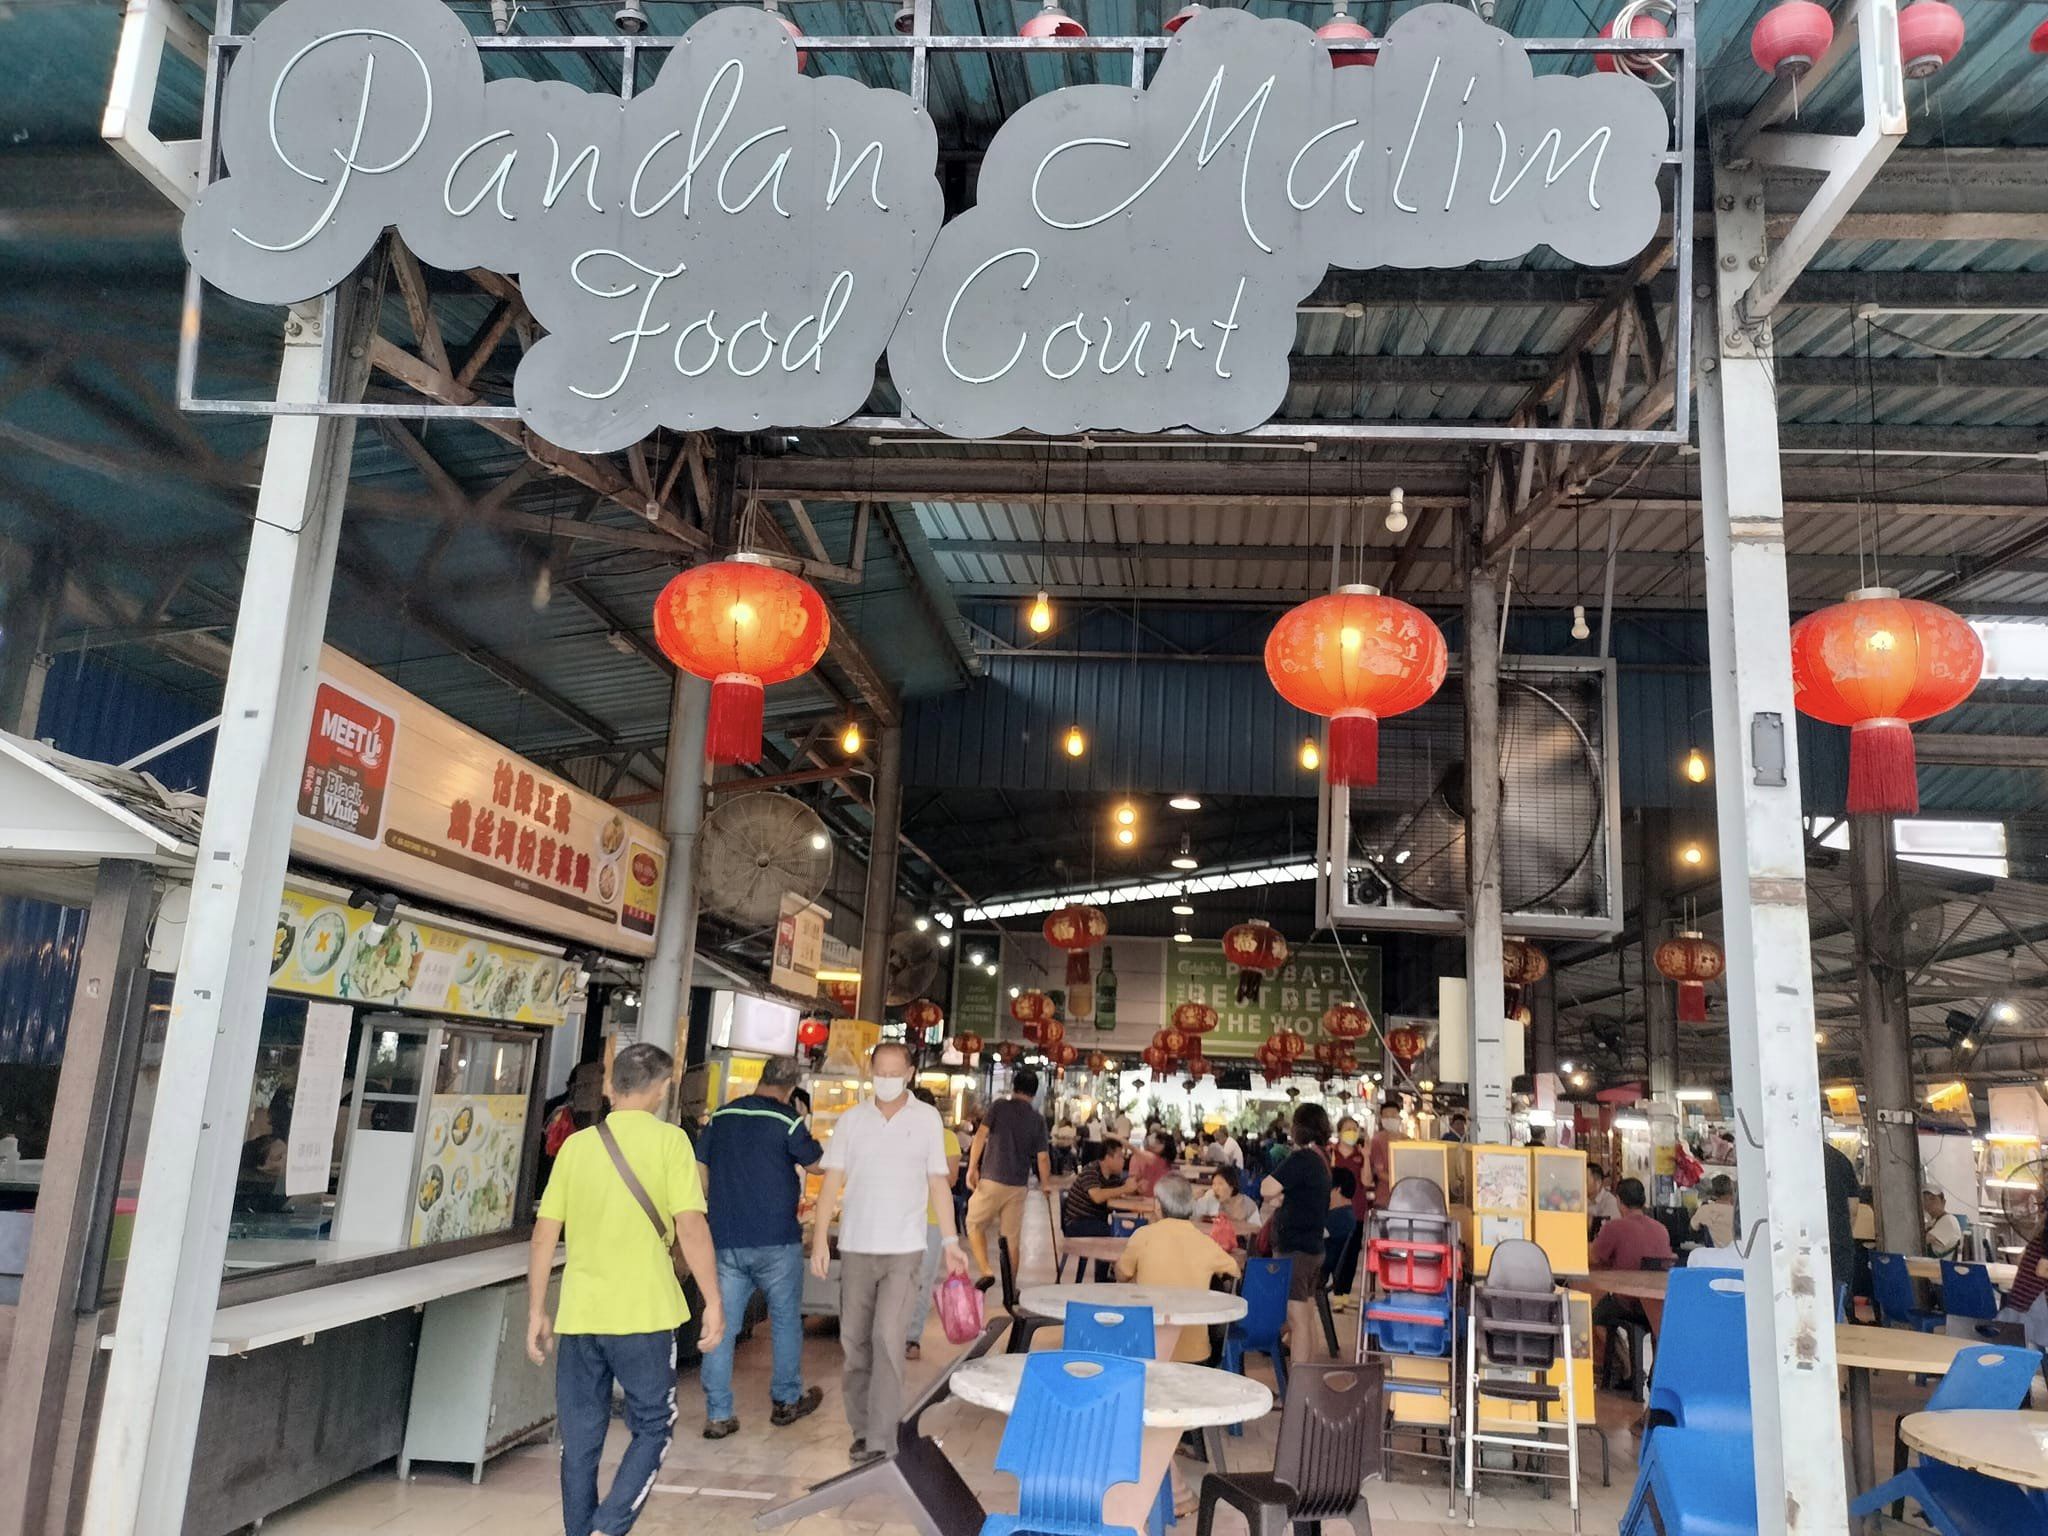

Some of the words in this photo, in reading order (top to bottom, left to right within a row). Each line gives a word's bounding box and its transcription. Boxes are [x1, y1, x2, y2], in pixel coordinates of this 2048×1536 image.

[232, 27, 889, 252] Pandan
[1031, 56, 1612, 254] Malim
[568, 248, 854, 399] Food
[942, 247, 1246, 384] Court
[323, 793, 360, 825] White
[1226, 961, 1368, 985] POBABLY
